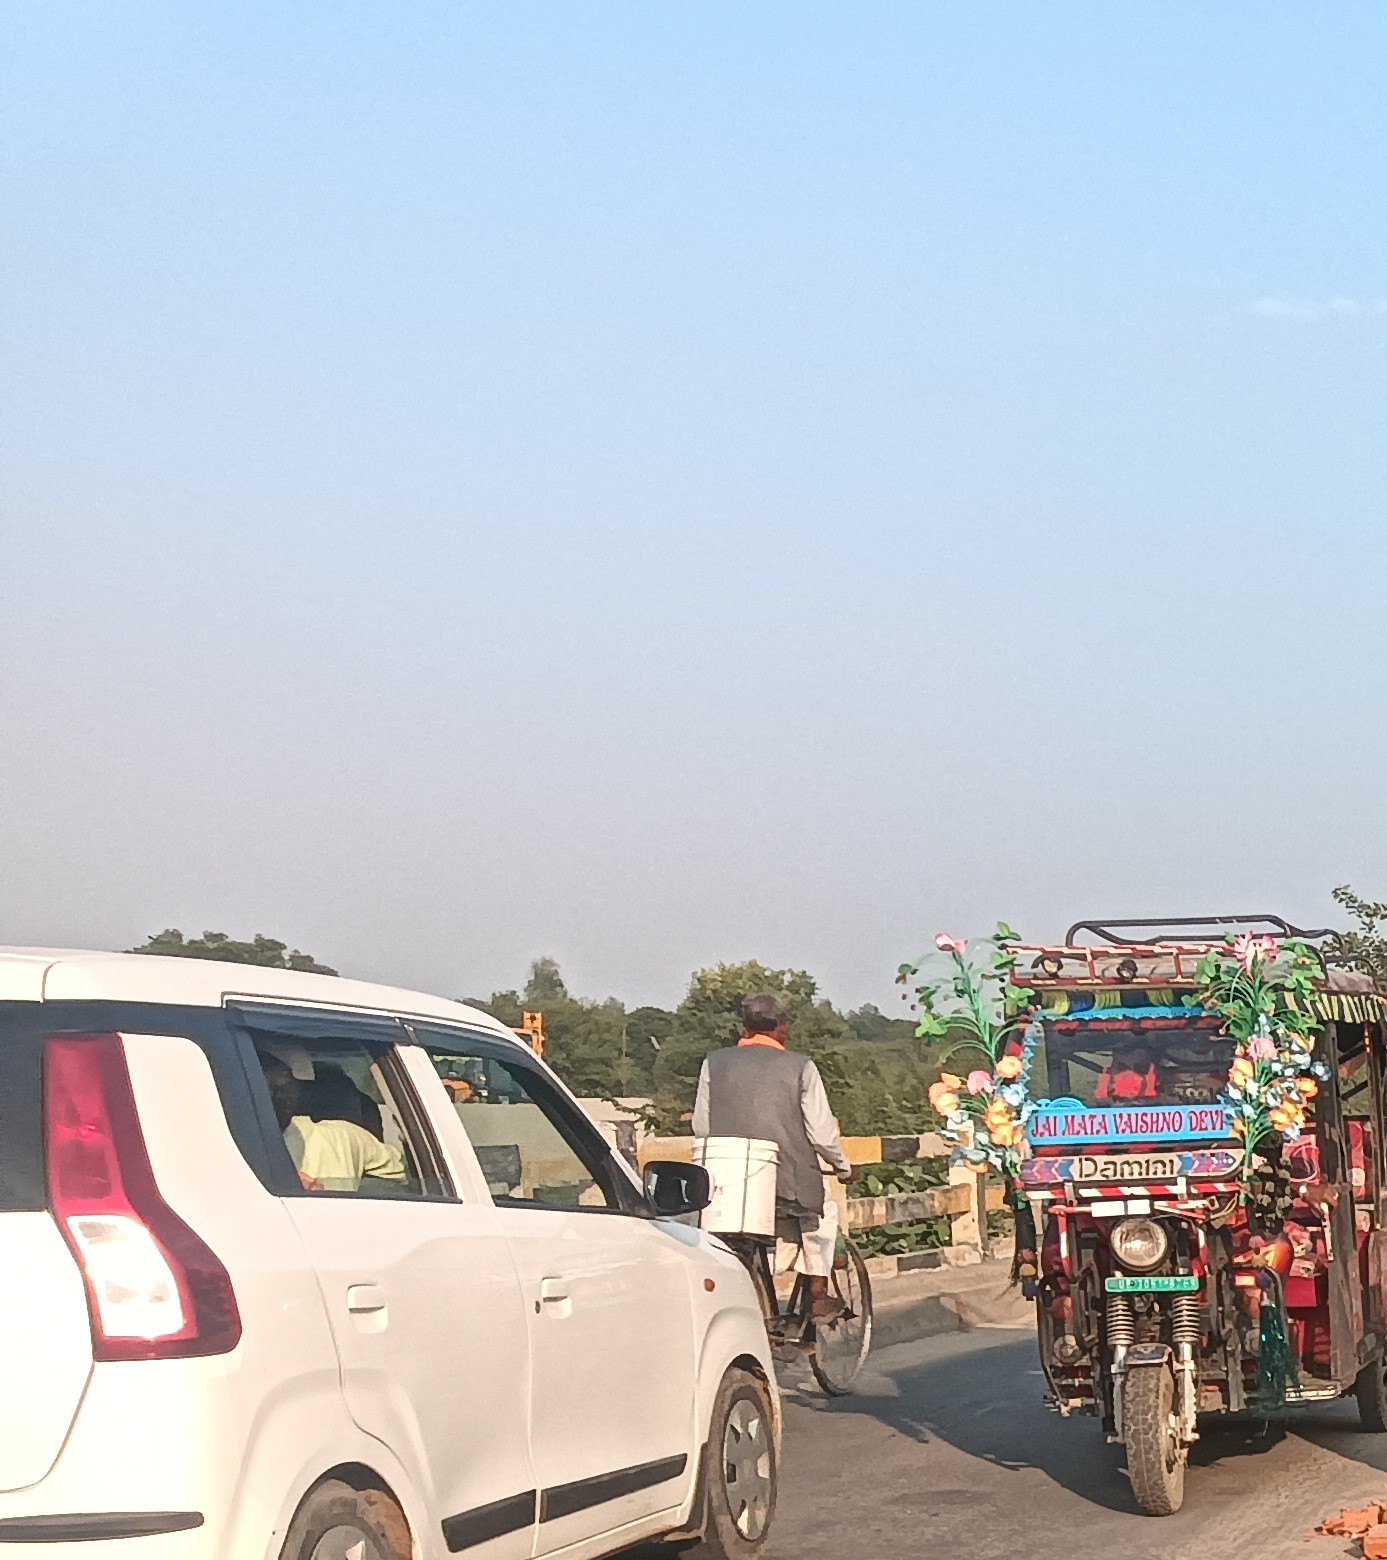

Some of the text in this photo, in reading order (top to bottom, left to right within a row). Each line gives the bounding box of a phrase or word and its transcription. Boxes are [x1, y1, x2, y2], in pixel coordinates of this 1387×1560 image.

[1031, 1109, 1224, 1138] JAI MATA VAISHNO DEVI
[1078, 1156, 1174, 1179] Damini
